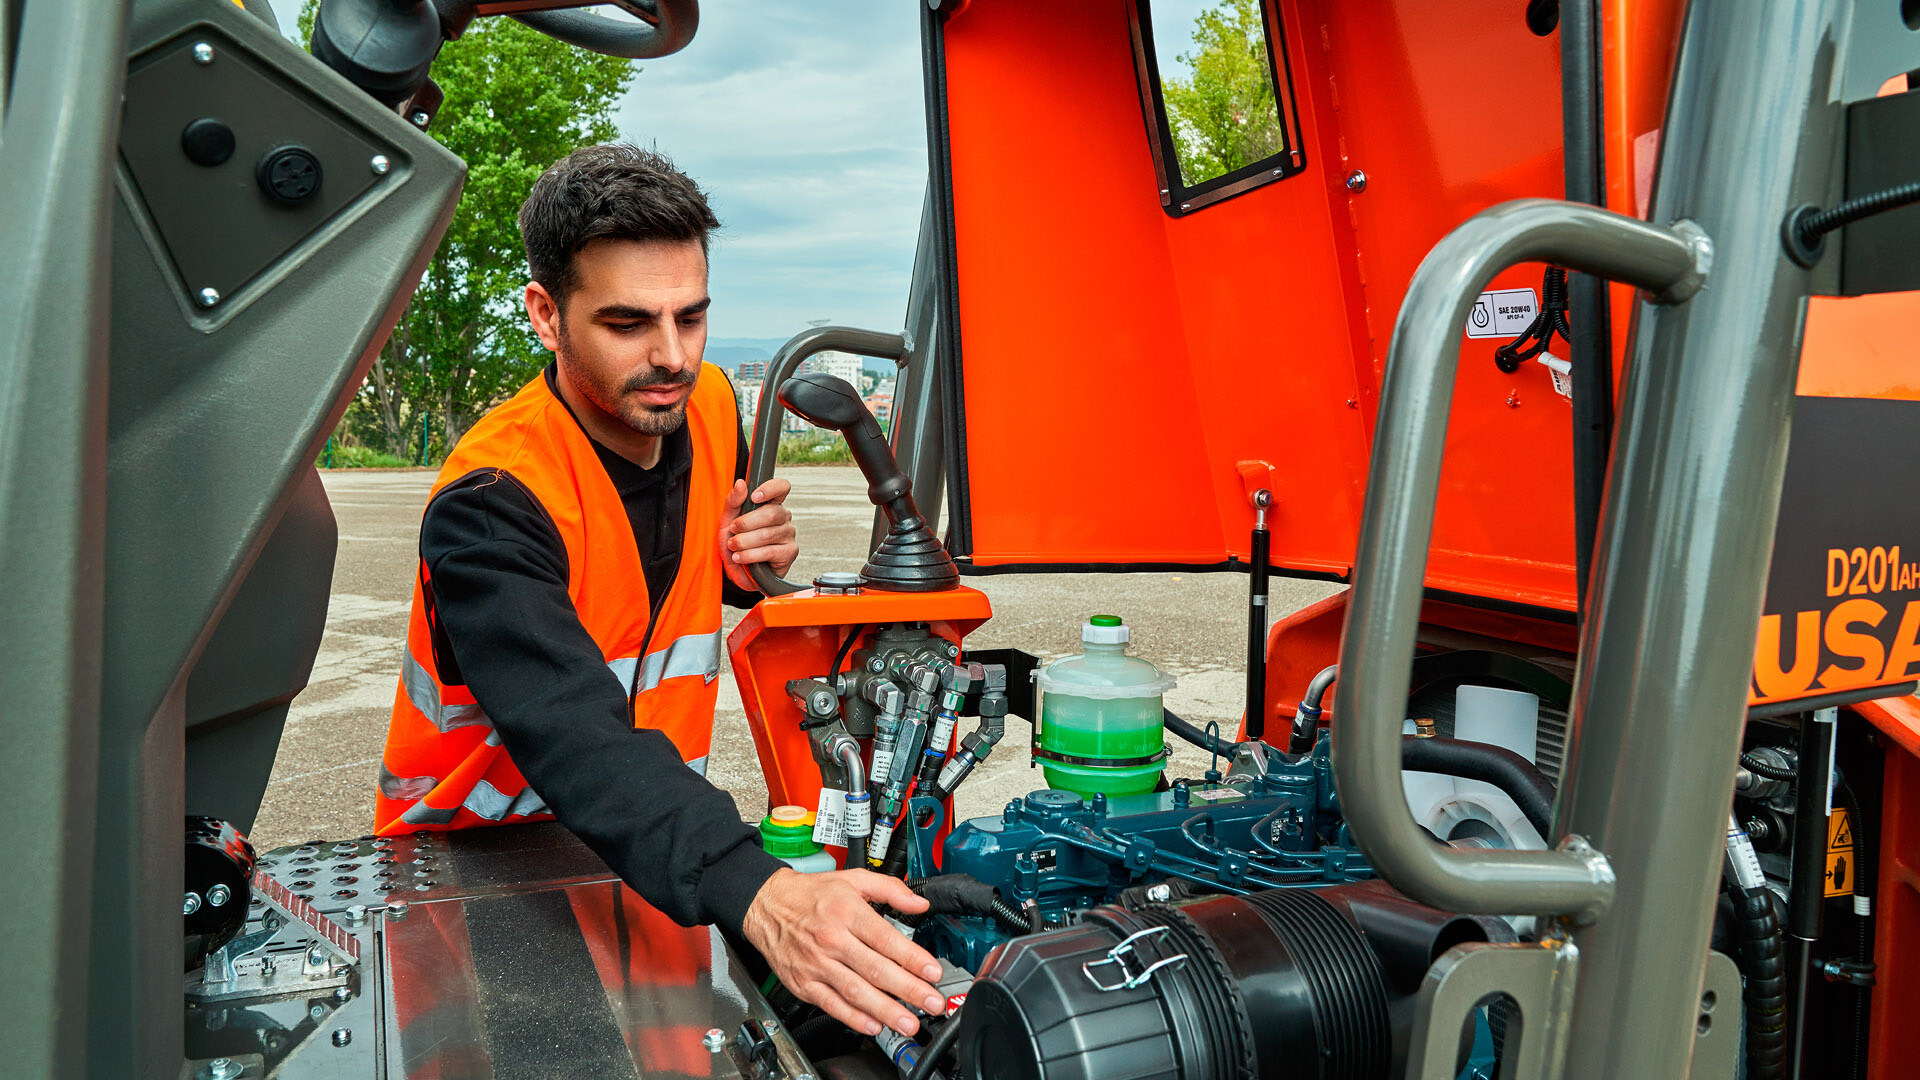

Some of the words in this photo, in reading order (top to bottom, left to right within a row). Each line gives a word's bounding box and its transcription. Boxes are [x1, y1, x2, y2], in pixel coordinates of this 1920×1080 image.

[1511, 305, 1531, 313] 20W40
[1827, 546, 1920, 597] D201AH
[1748, 598, 1920, 702] USA
